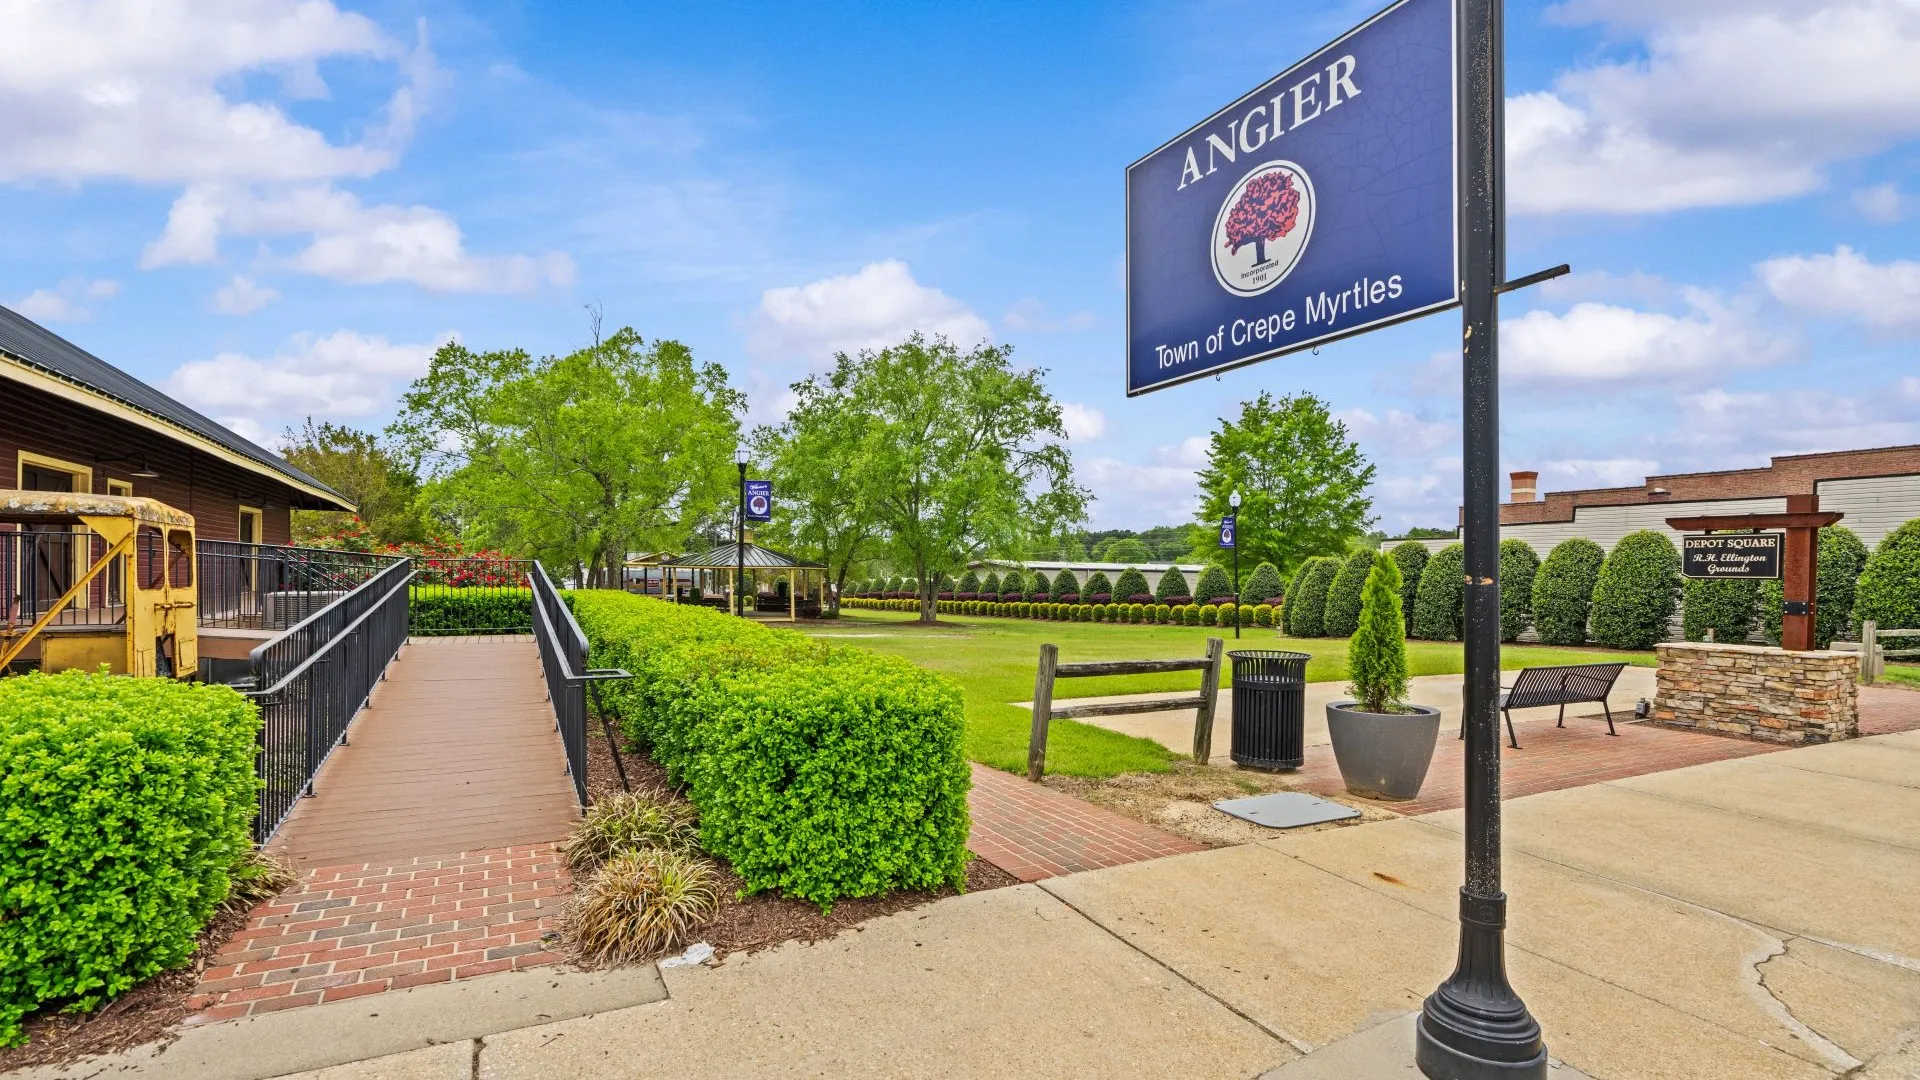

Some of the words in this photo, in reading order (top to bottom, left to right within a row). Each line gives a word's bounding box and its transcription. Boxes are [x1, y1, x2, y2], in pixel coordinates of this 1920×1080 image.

[1177, 54, 1361, 191] ANGIER
[1252, 273, 1267, 285] 1901
[1156, 340, 1199, 369] Town
[1206, 325, 1224, 354] of
[1231, 309, 1295, 345] Crepe
[1306, 274, 1403, 326] Myrtles
[1685, 540, 1724, 548] DEPOT
[1727, 538, 1775, 549] SQUARE
[1692, 553, 1718, 562] R.H.
[1720, 553, 1766, 563] Ellington
[1707, 563, 1750, 574] Grounds
